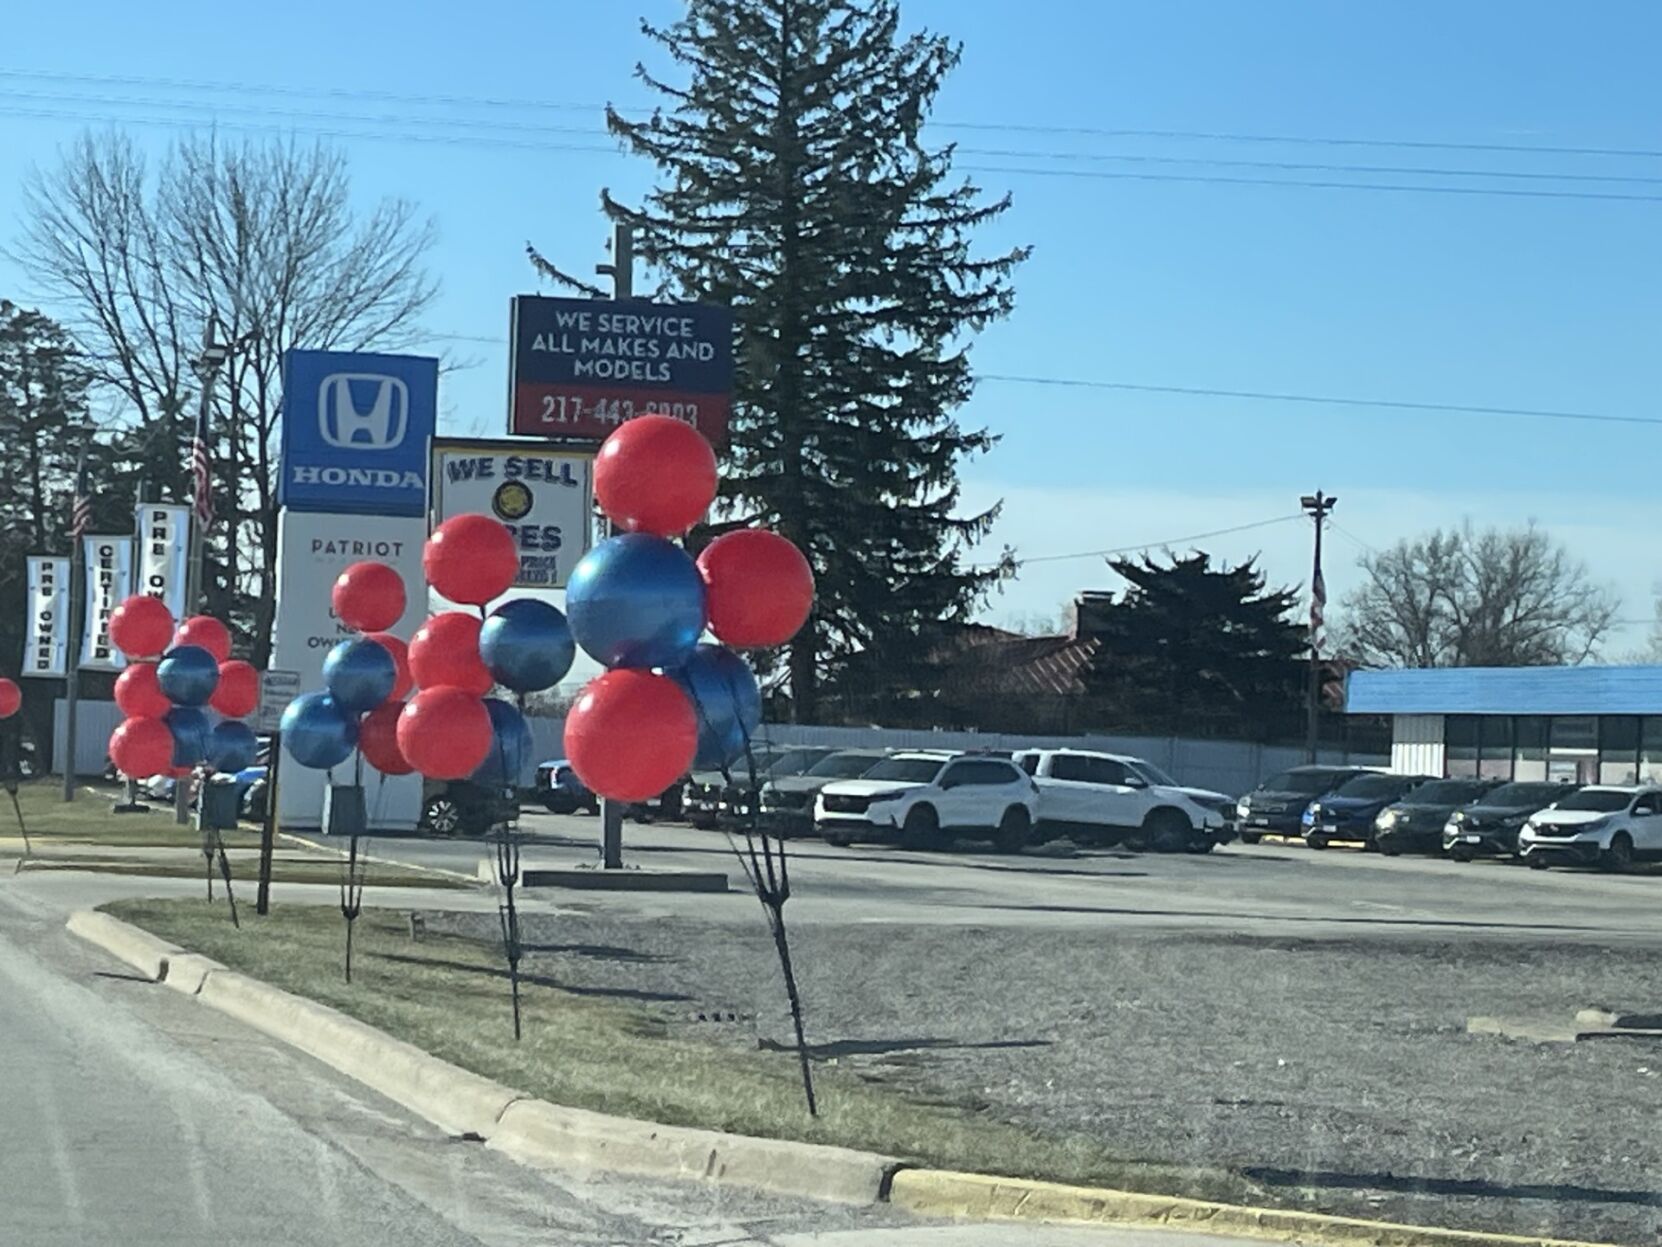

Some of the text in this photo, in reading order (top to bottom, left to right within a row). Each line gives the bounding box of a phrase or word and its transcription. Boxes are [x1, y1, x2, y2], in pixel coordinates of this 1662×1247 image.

[556, 311, 695, 338] WE SERVICE
[532, 333, 714, 361] ALL MAKES AND
[574, 359, 671, 382] MODELS
[293, 466, 424, 489] HONDA
[447, 455, 578, 488] WE SELL
[152, 511, 167, 555] PRE
[312, 539, 403, 557] PATRIOT
[37, 562, 53, 670] PRE OWNED
